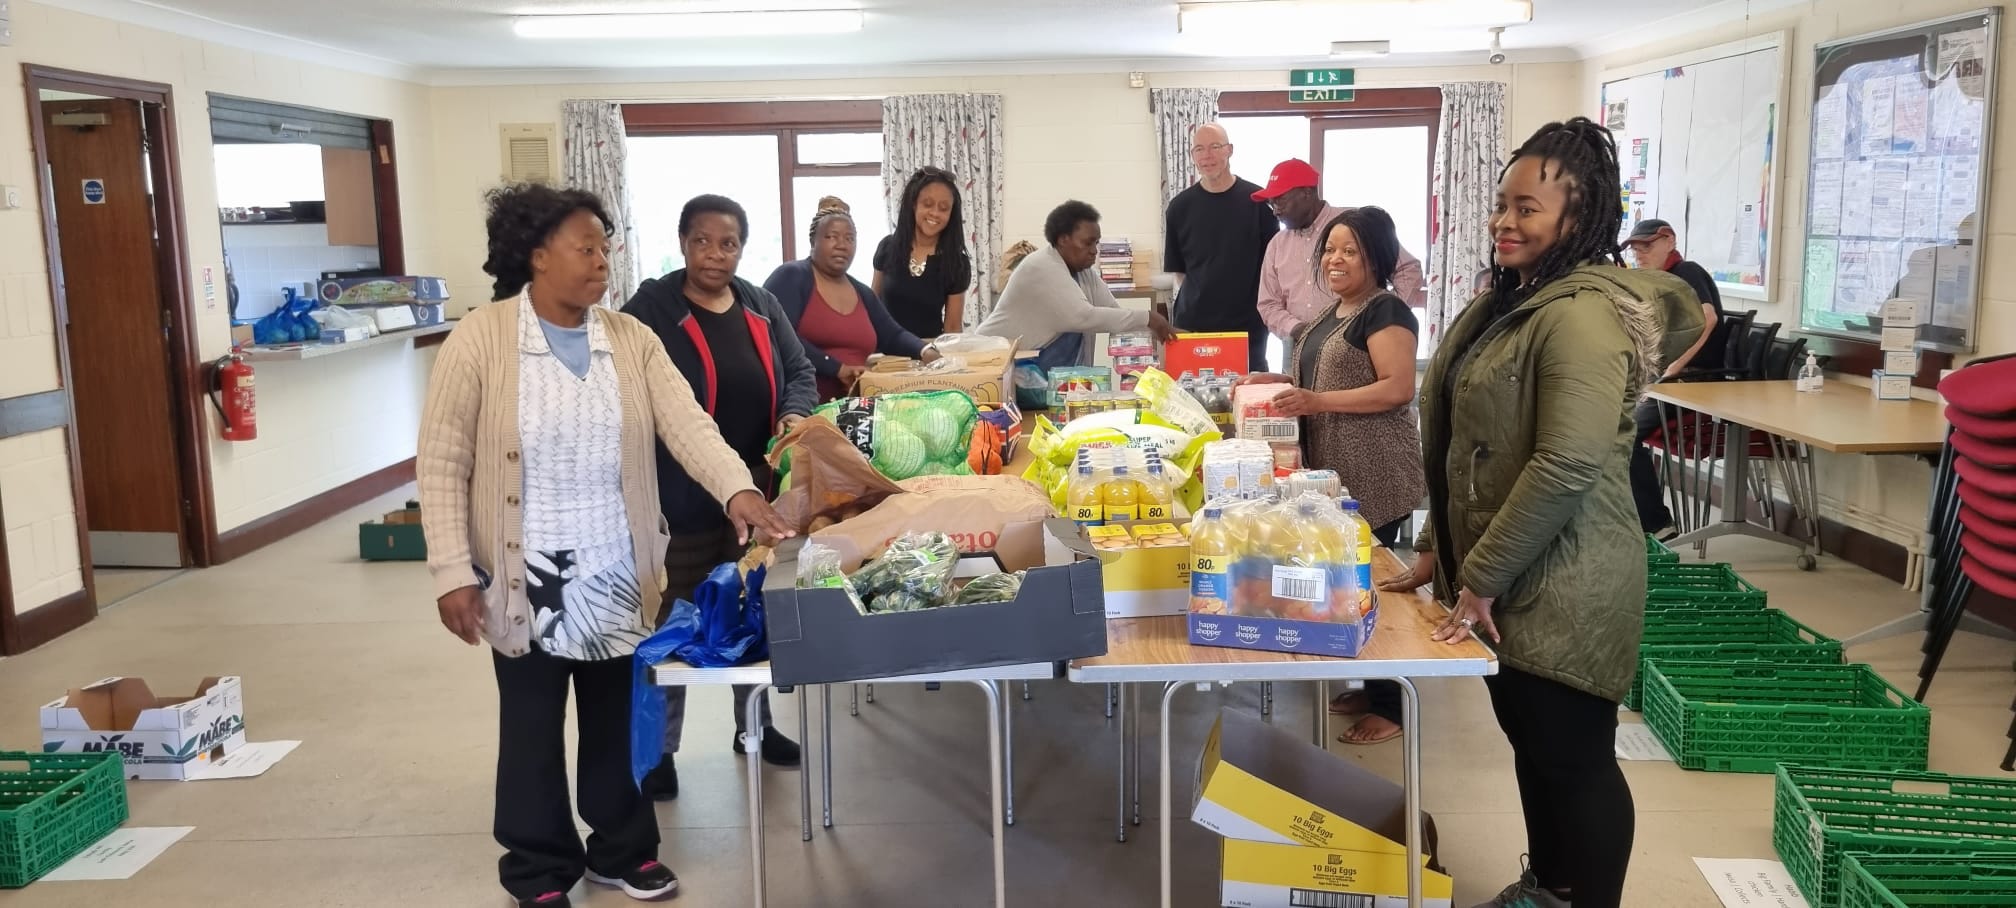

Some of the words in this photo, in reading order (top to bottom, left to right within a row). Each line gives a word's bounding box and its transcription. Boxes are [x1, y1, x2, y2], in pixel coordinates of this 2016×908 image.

[1197, 558, 1215, 572] 80p
[1198, 620, 1218, 631] happy
[1238, 623, 1258, 634] happy
[1196, 627, 1222, 637] shopper
[1235, 631, 1261, 641] shopper
[1278, 626, 1299, 637] happy
[1275, 634, 1302, 644] shopper
[1293, 815, 1303, 824] 10
[1303, 819, 1316, 831] Big
[1316, 825, 1334, 839] Eggs
[1313, 864, 1322, 872] 10
[1324, 865, 1337, 874] Big
[1339, 866, 1357, 876] Eggs
